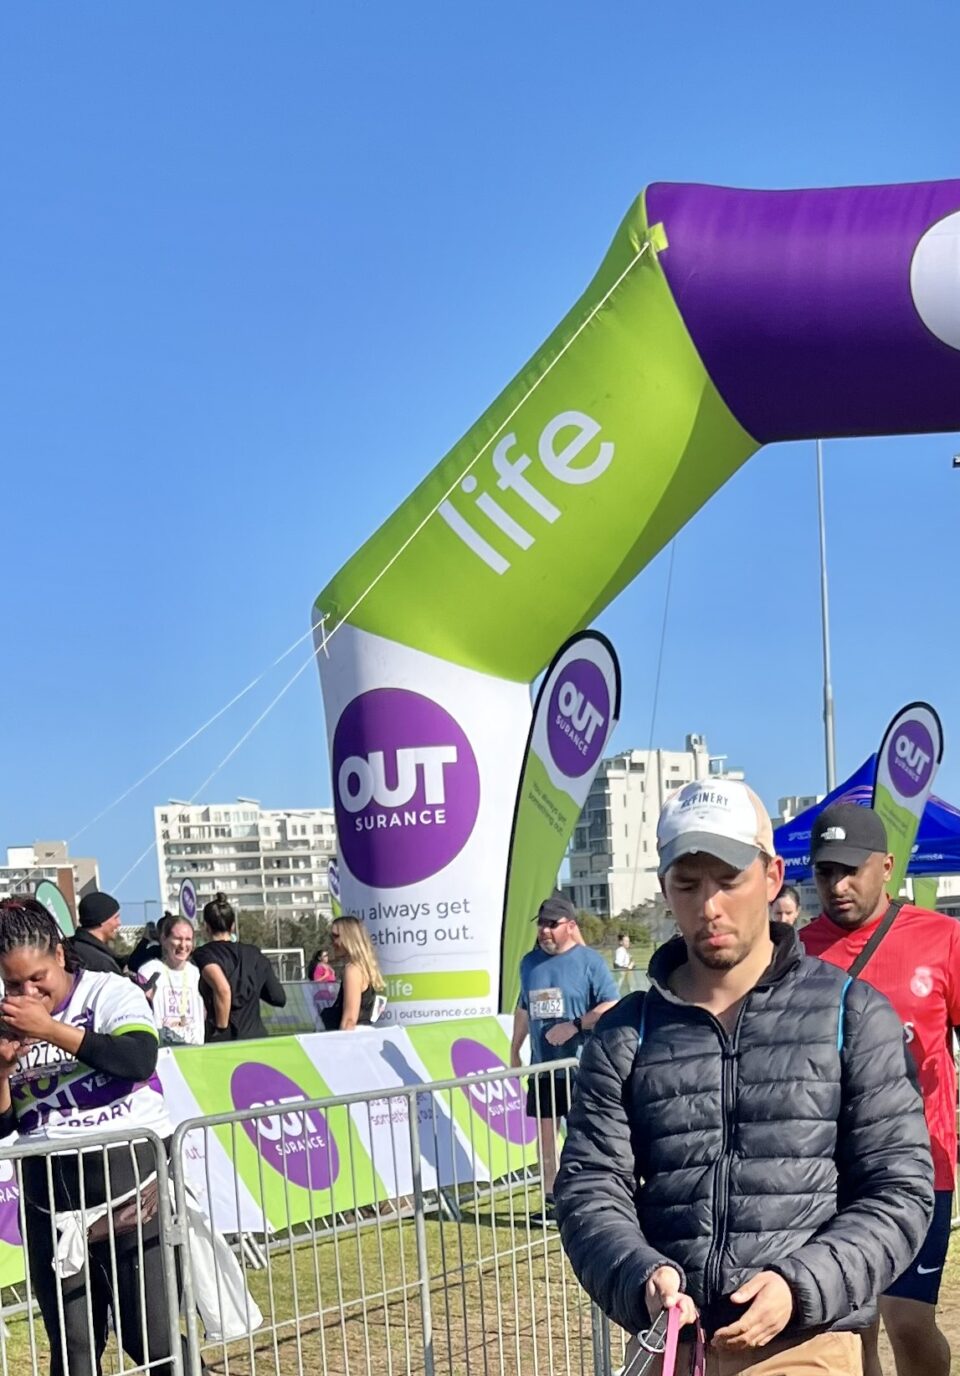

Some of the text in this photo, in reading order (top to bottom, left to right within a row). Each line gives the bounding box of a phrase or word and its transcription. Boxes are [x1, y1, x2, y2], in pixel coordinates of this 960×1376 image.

[438, 410, 615, 575] life
[558, 681, 605, 744] OUT
[555, 714, 589, 757] SURANCE
[895, 735, 931, 775] OUT
[339, 745, 457, 813] OUT
[355, 809, 447, 832] SURANCE
[369, 902, 430, 921] always
[436, 898, 470, 919] get
[370, 925, 475, 946] ething out.
[386, 979, 413, 997] life
[400, 1006, 491, 1019] outsurance.co.za
[249, 1095, 317, 1141] OUT
